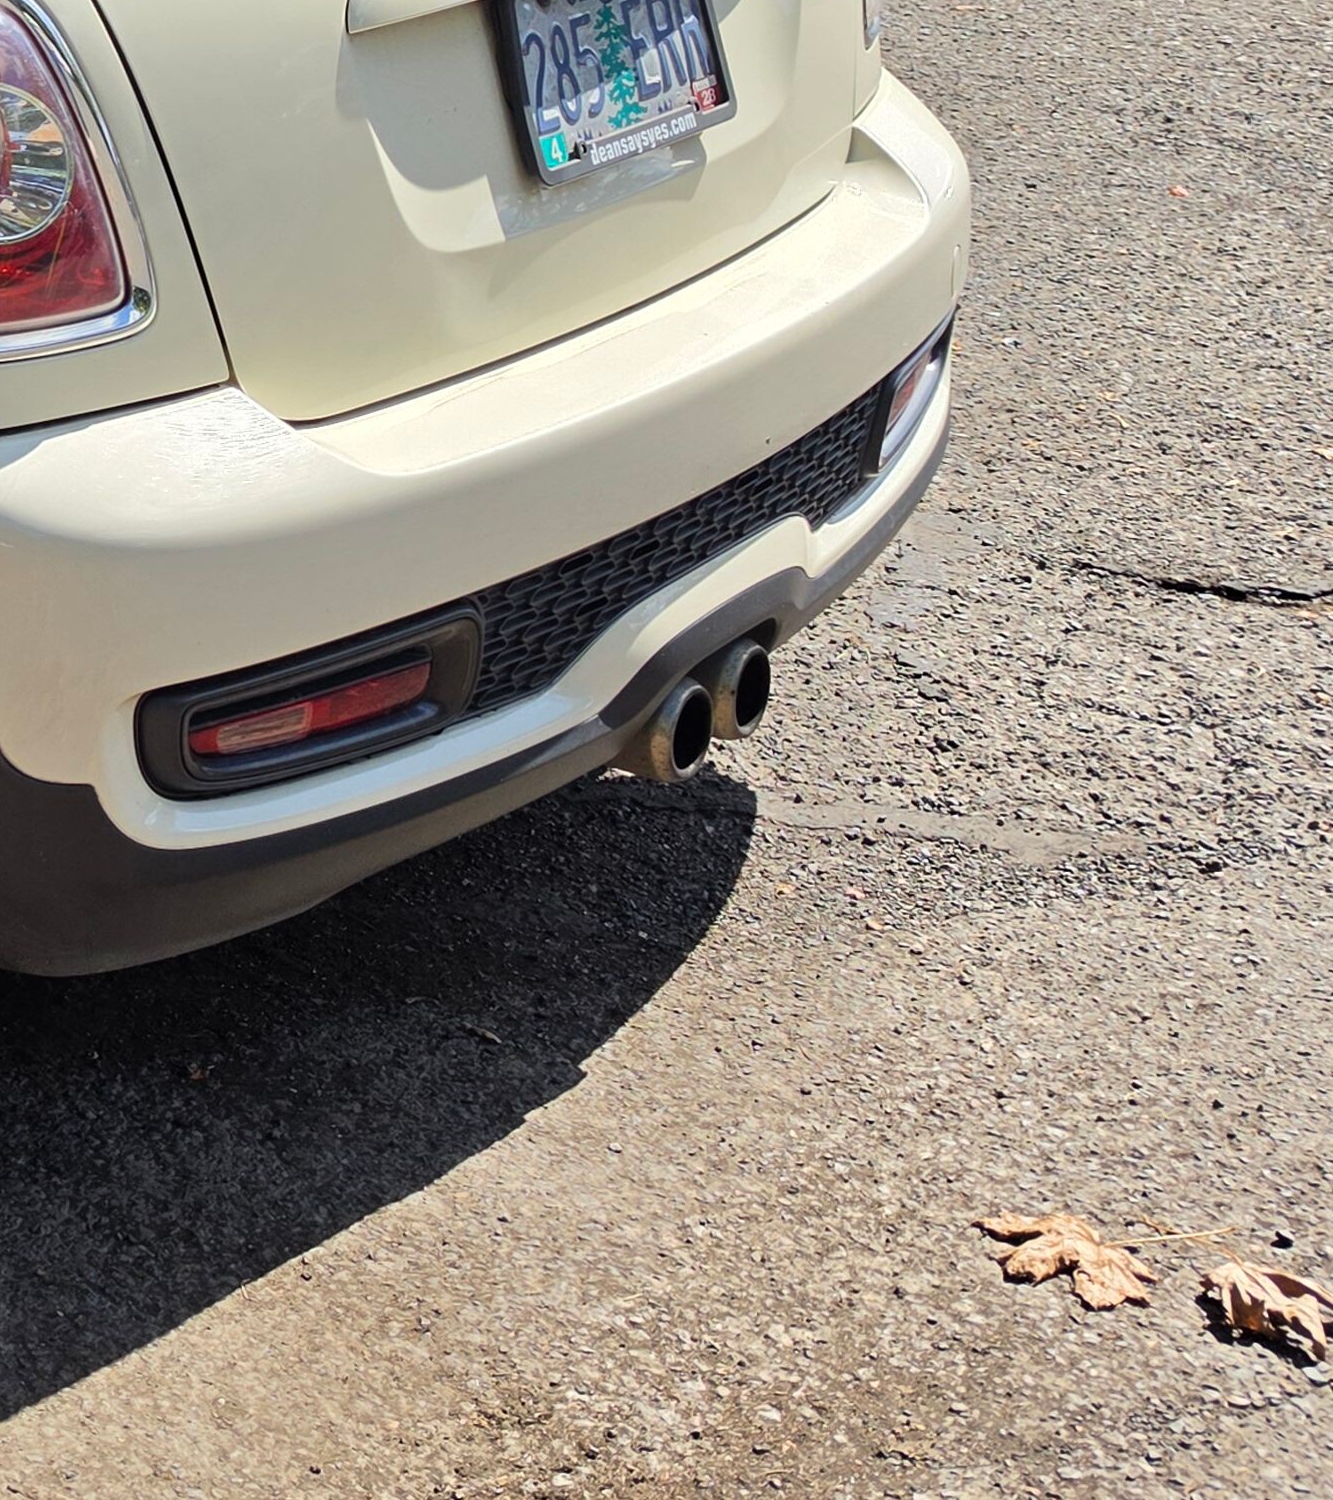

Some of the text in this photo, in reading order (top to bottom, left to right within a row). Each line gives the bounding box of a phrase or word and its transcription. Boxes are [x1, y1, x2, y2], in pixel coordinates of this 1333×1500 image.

[523, 12, 605, 132] 285
[550, 137, 564, 162] 4
[590, 111, 697, 165] deansaysyes.com
